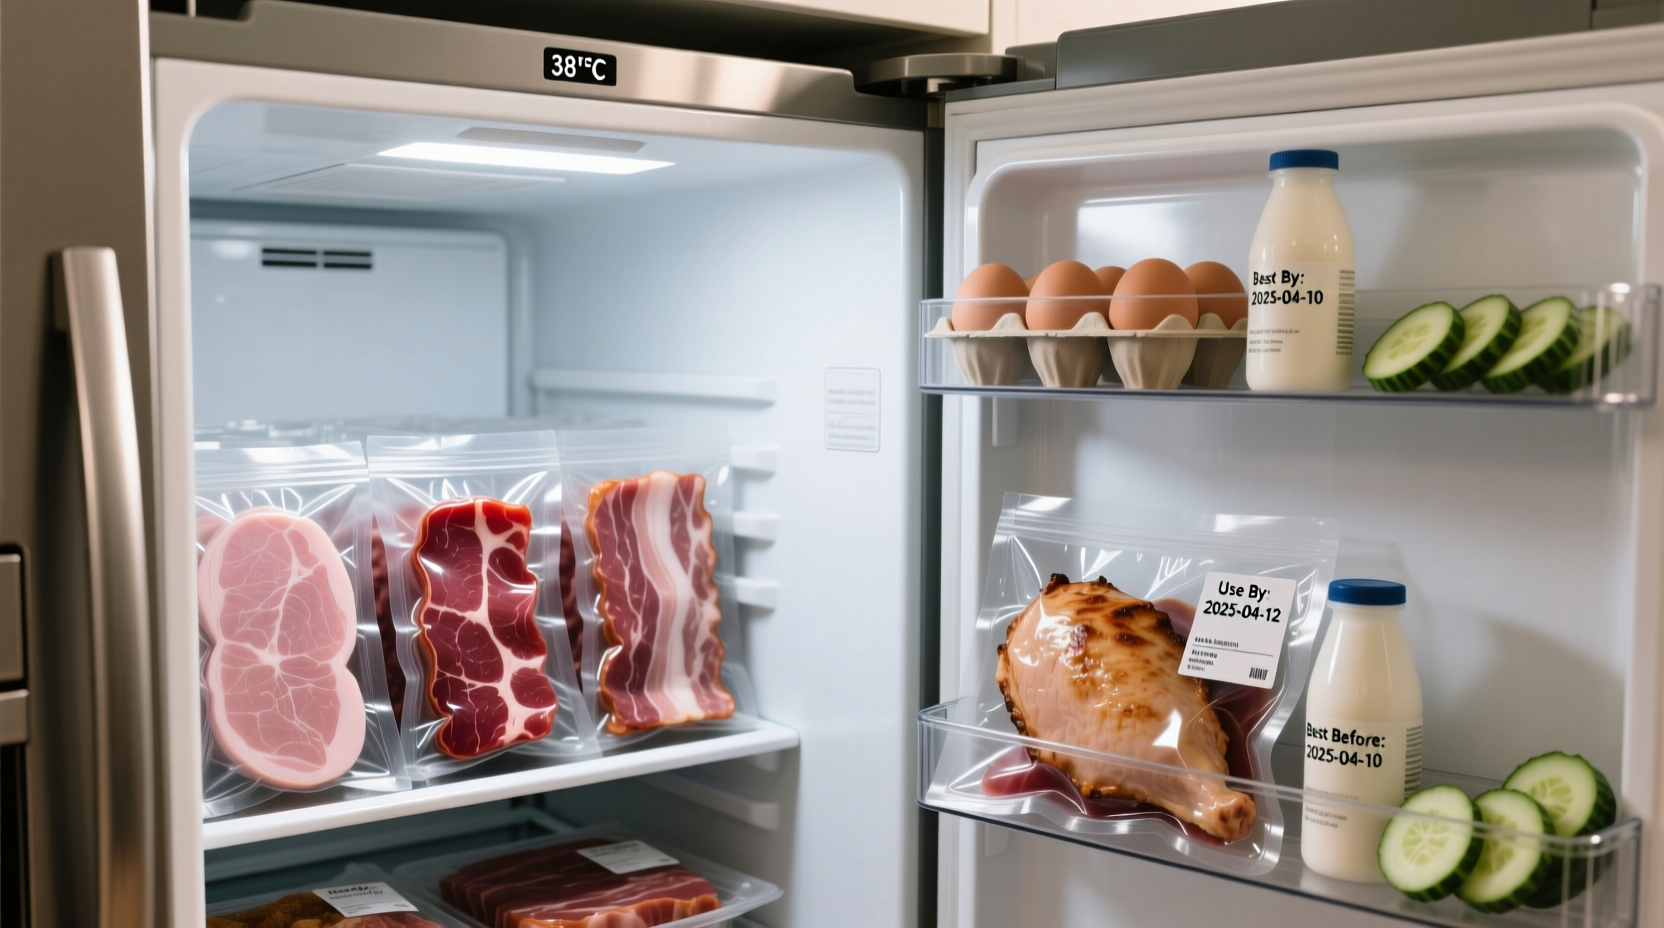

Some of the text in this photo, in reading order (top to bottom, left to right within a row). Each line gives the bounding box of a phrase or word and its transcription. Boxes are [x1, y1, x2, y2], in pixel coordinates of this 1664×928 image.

[1253, 270, 1304, 288] Best By:
[1251, 289, 1324, 306] 2025-04-10
[1218, 580, 1244, 597] Use
[1203, 599, 1282, 623] 2025-04-12
[1307, 722, 1386, 748] Best Before:
[1306, 744, 1383, 768] 2025-04-10
